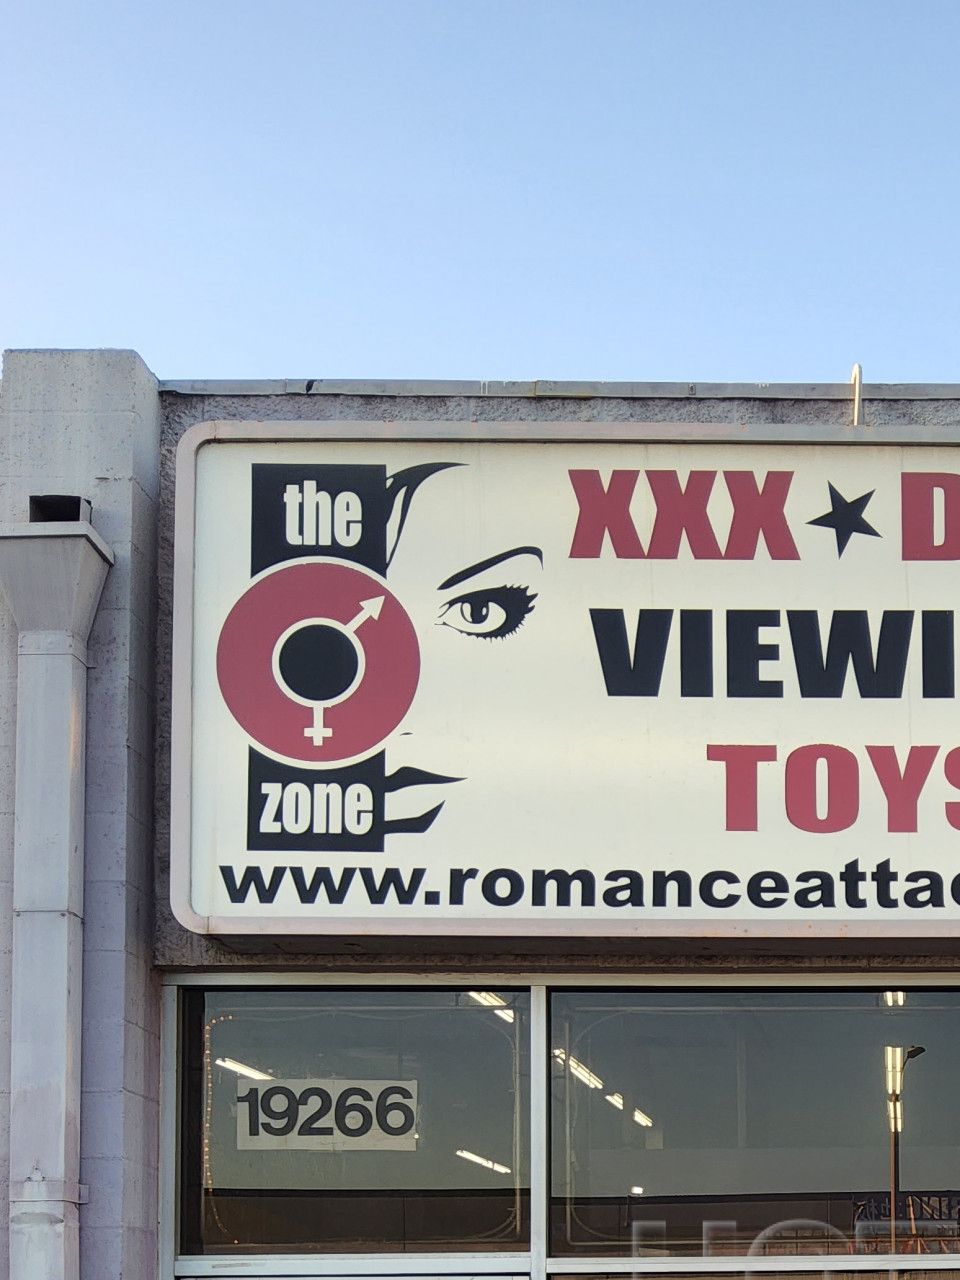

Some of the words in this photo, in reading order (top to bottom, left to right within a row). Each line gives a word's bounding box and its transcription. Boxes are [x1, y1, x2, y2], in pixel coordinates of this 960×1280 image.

[283, 480, 362, 548] the
[568, 469, 801, 561] XXX
[259, 780, 373, 836] zone
[238, 1085, 415, 1138] 19266
